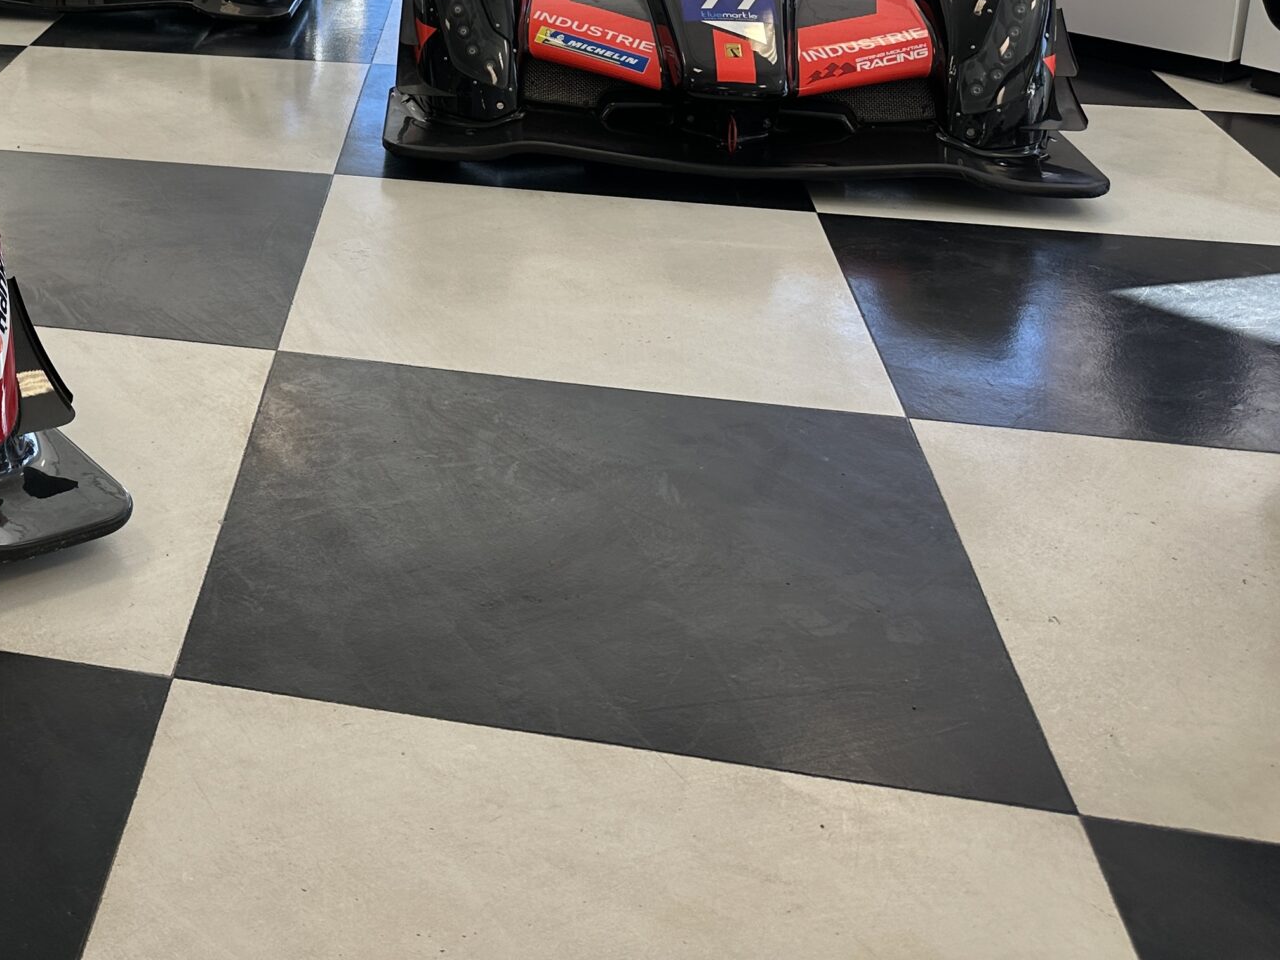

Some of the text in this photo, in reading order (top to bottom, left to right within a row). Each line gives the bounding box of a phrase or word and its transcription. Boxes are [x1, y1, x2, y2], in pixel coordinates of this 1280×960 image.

[533, 10, 656, 52] INDUSTRIE
[802, 28, 929, 62] INDUSTRIE
[567, 40, 639, 65] MICHELIN
[856, 48, 928, 71] RACING
